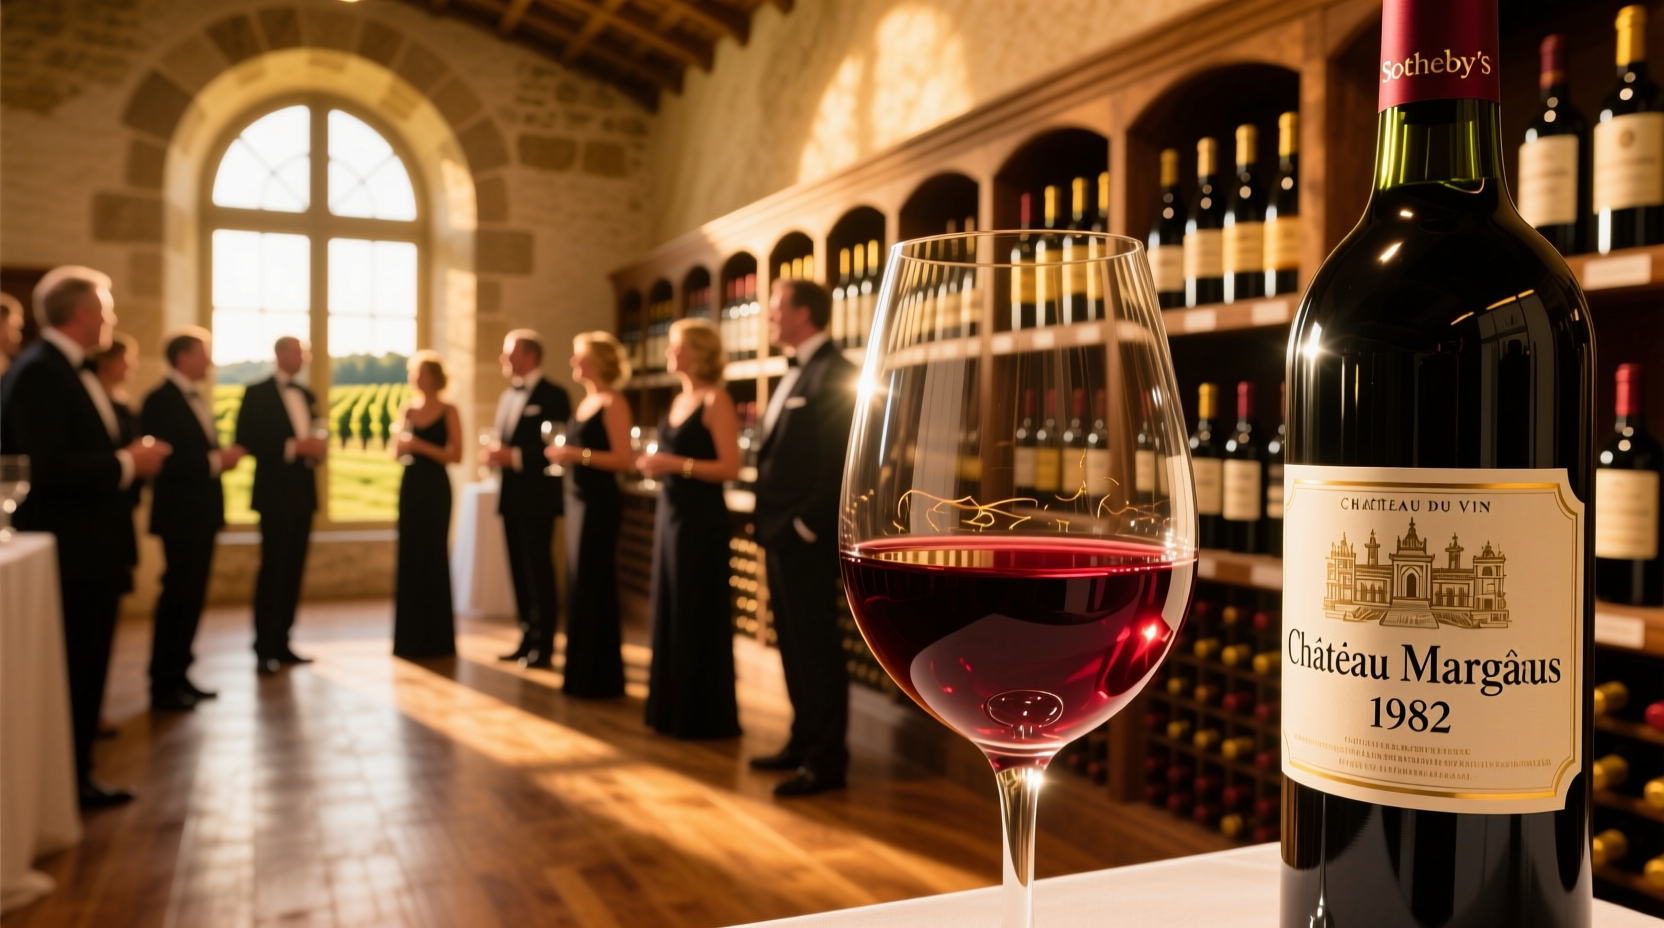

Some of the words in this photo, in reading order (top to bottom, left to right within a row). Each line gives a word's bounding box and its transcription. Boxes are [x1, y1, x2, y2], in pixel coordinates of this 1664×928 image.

[1382, 49, 1491, 83] Sotheby's
[1428, 500, 1451, 513] DU
[1459, 501, 1491, 513] VIN
[1370, 696, 1451, 734] 1982
